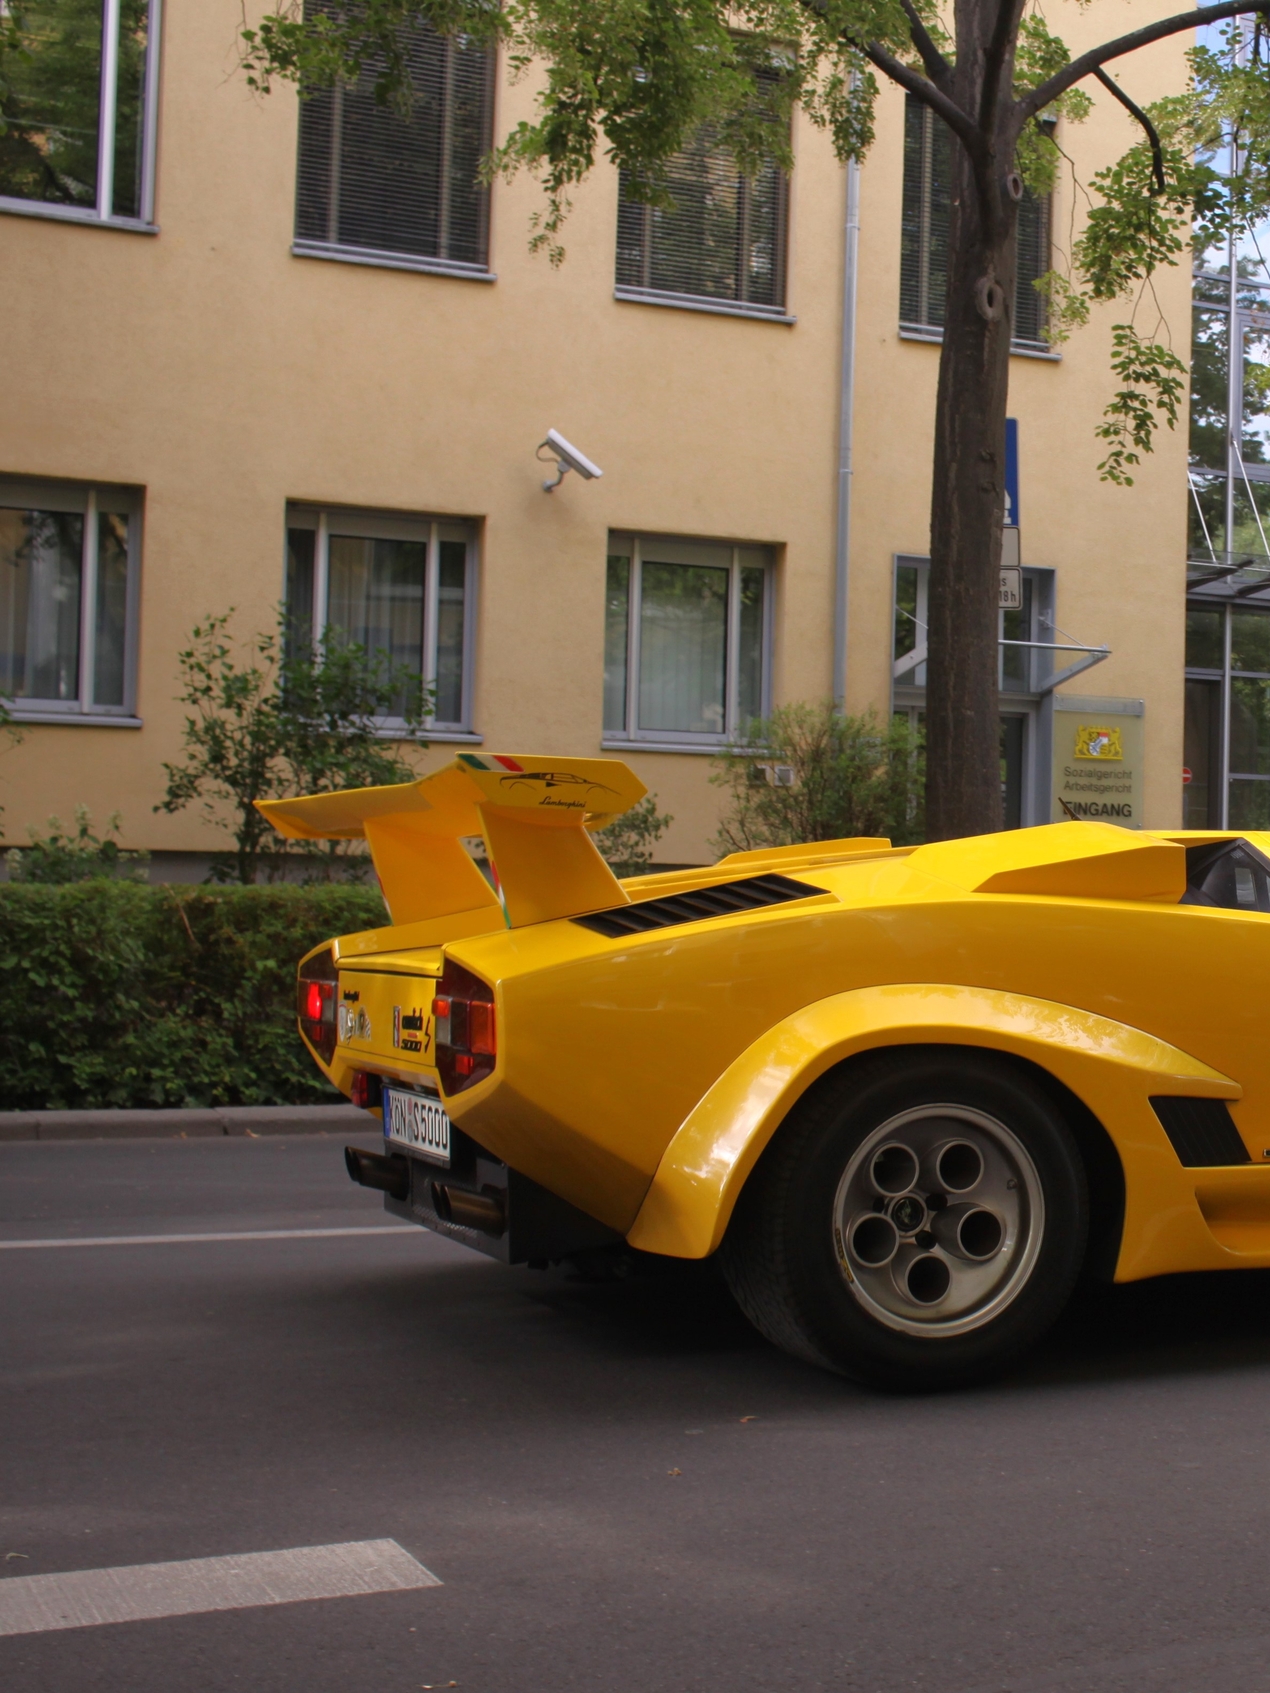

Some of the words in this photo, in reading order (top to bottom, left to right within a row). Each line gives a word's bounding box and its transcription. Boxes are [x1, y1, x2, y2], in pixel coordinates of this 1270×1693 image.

[1063, 766, 1132, 781] Sozialgericht
[1063, 780, 1132, 794] Arbeitsgericht
[539, 796, 586, 809] Lamborghini
[388, 1094, 407, 1138] KÖN
